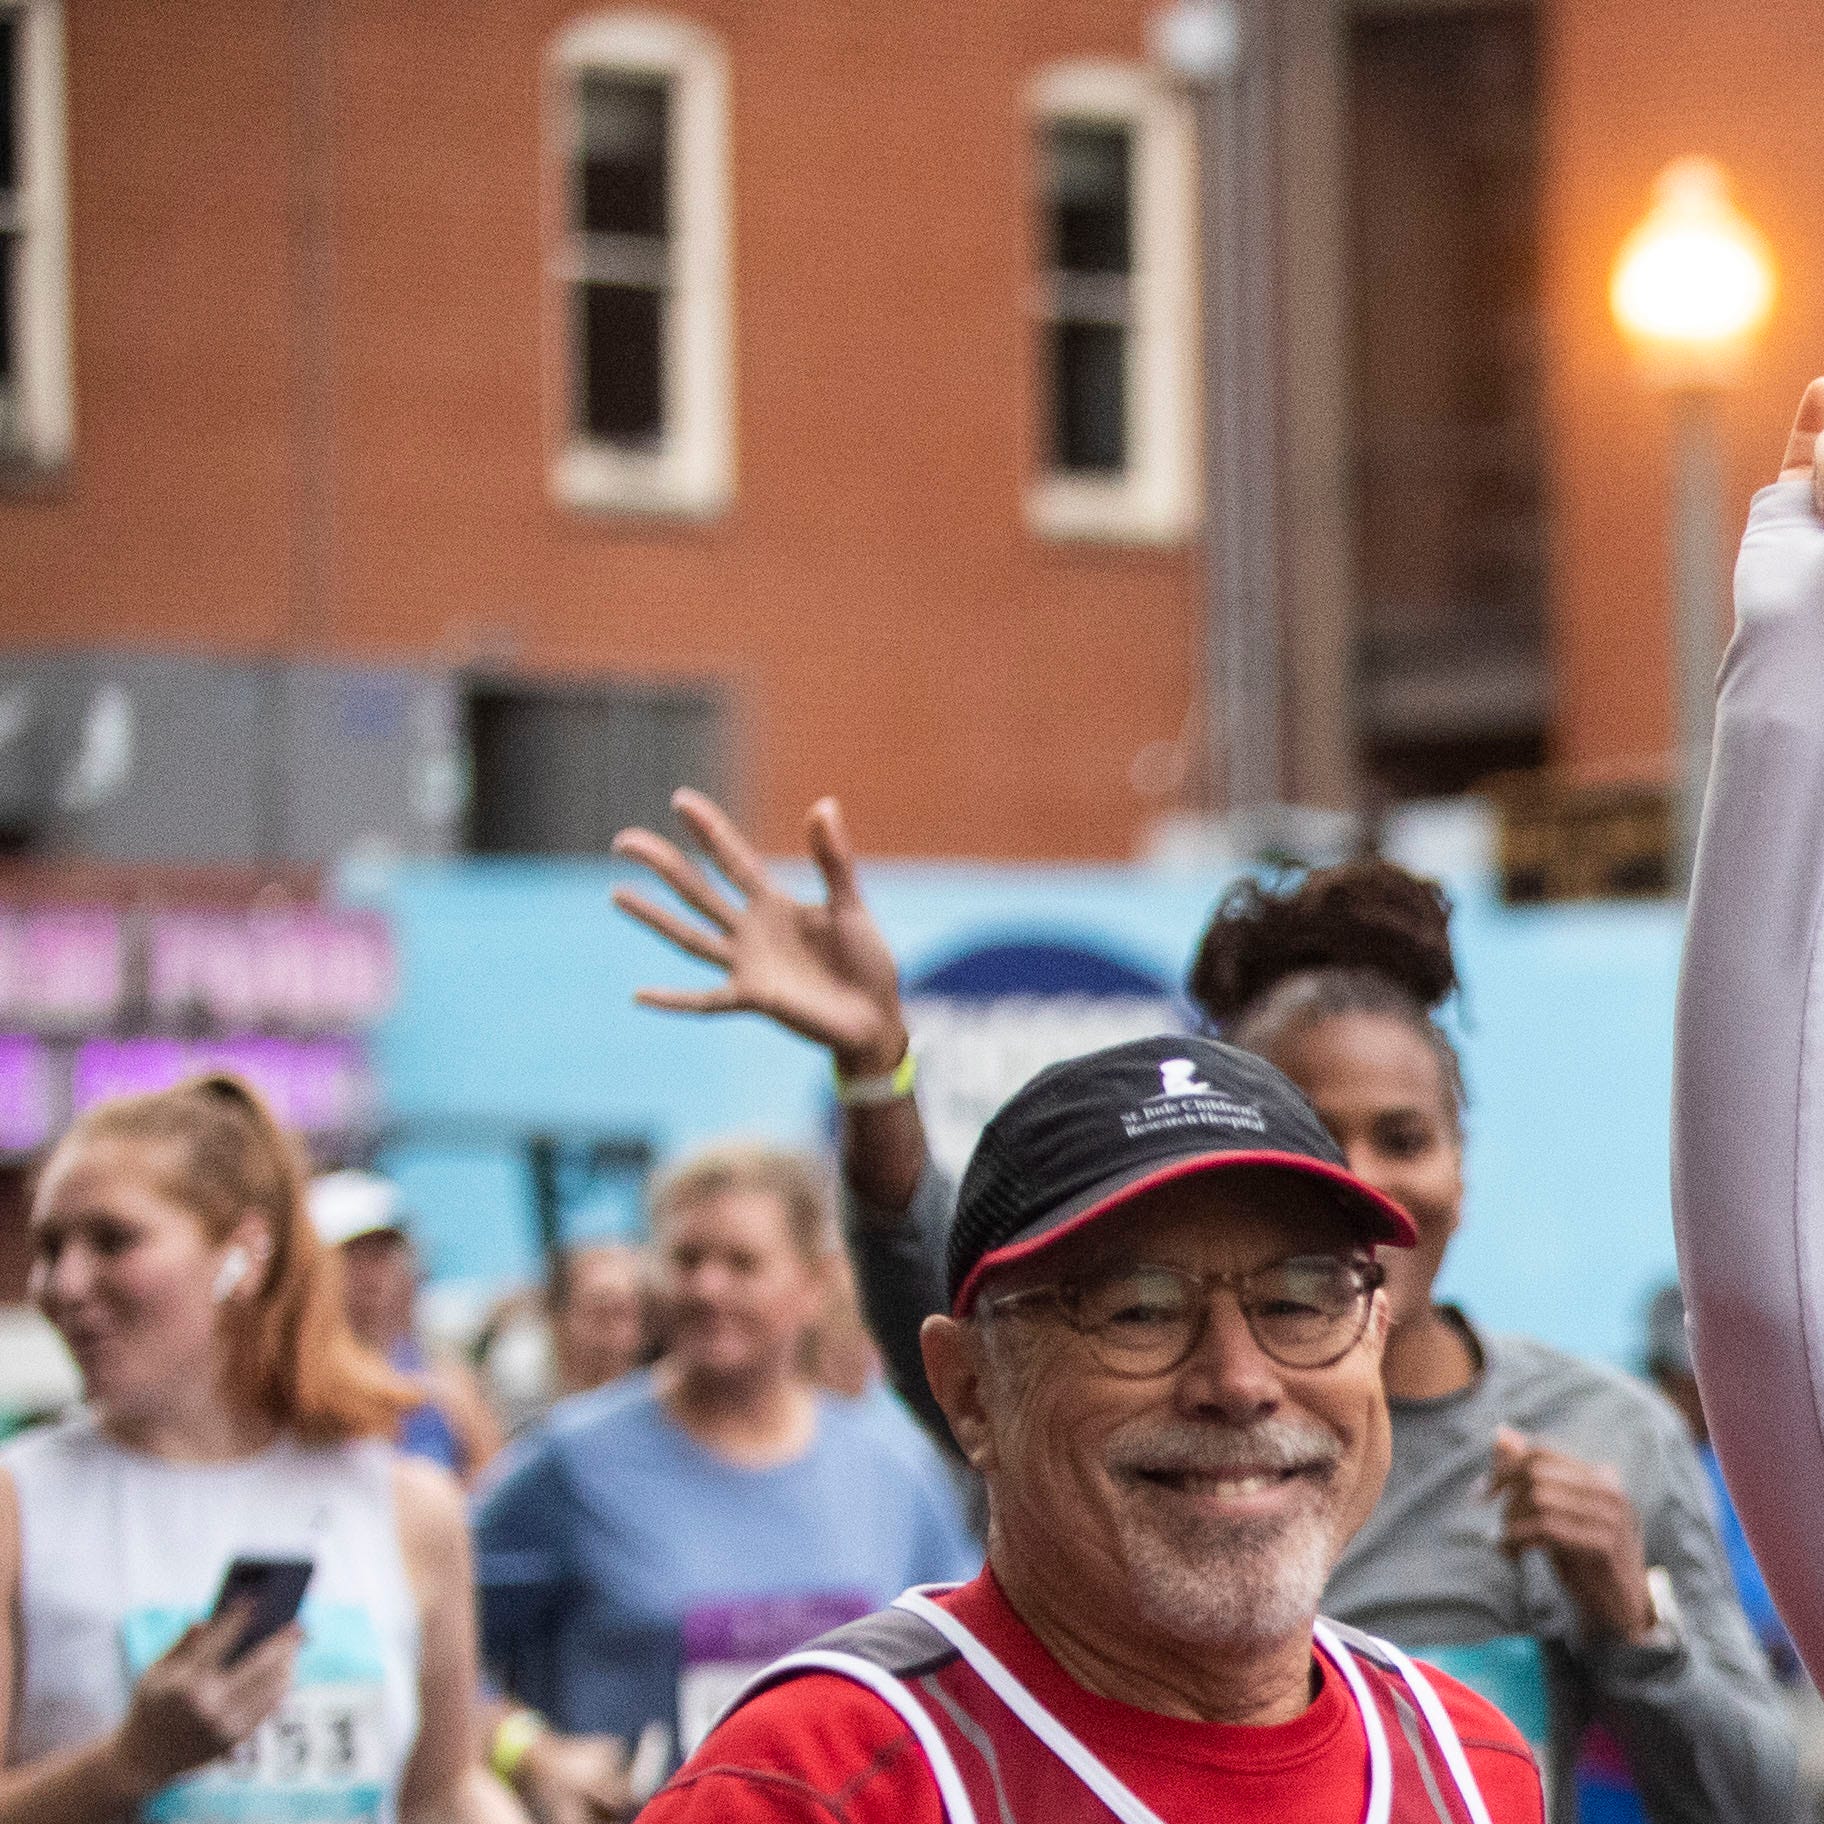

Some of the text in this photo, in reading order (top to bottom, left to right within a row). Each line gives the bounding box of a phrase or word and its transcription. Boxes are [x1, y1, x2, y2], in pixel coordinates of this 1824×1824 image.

[1143, 1102, 1179, 1119] Jude
[1125, 1112, 1266, 1137] Research Hospital
